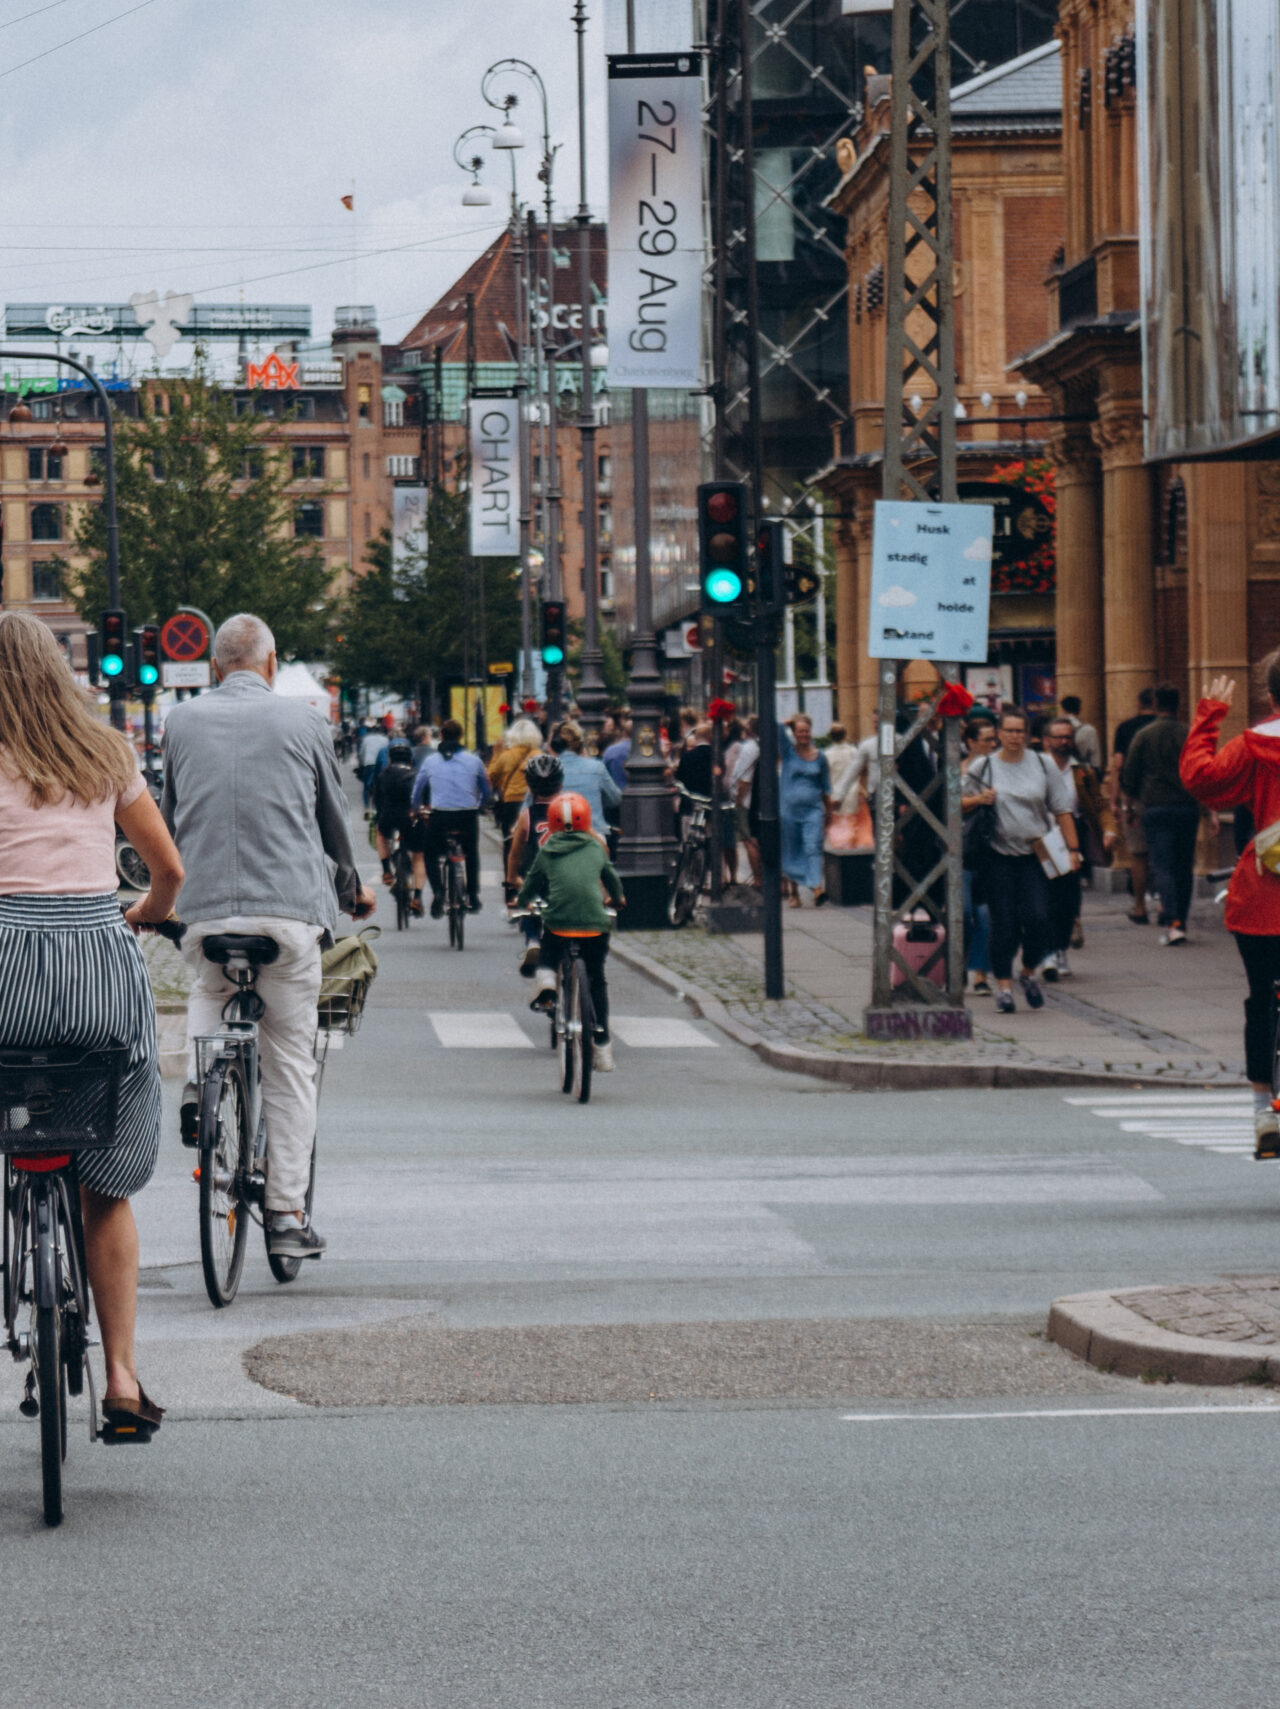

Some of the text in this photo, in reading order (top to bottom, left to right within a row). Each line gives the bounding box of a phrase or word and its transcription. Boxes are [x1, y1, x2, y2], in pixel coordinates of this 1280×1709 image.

[46, 305, 114, 337] Carlsberg
[629, 267, 678, 353] Aug
[247, 353, 299, 390] MAX
[480, 411, 511, 534] CHART
[917, 524, 950, 535] Husk
[887, 552, 928, 567] stadig
[962, 576, 976, 585] at
[937, 602, 975, 613] holde
